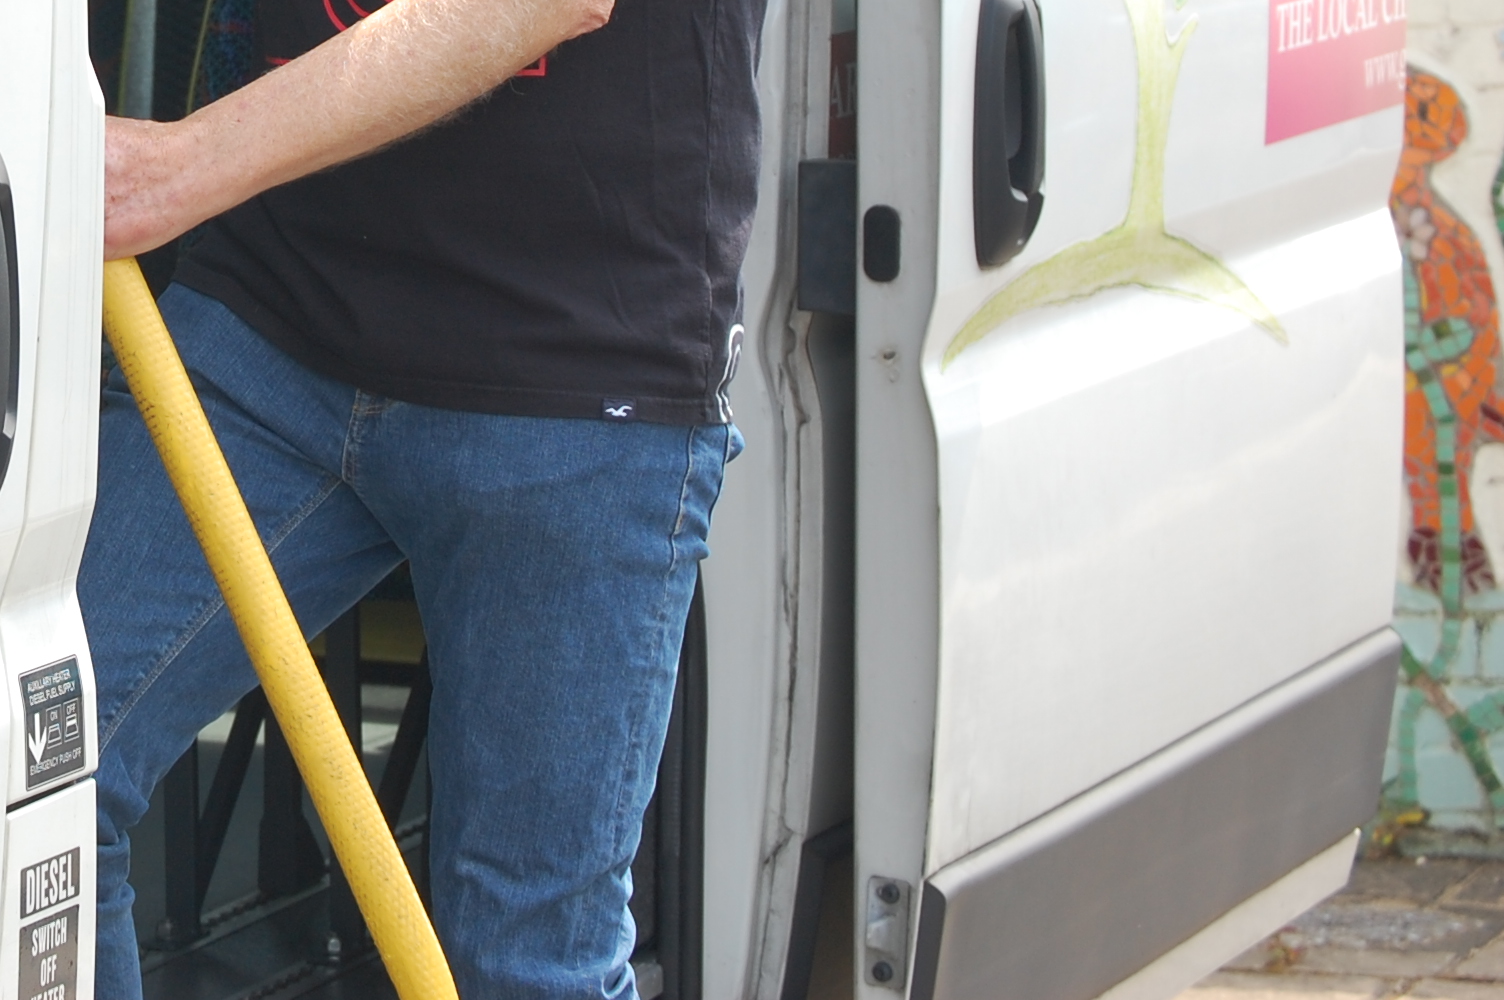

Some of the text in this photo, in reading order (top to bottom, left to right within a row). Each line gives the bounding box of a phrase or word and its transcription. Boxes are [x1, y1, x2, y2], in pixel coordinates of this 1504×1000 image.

[50, 710, 58, 721] ON
[66, 703, 77, 716] OFF
[59, 752, 72, 764] PUSH
[72, 747, 82, 759] OFF
[25, 853, 75, 915] DIESEL
[31, 916, 67, 957] SWITCH
[40, 954, 57, 987] OFF
